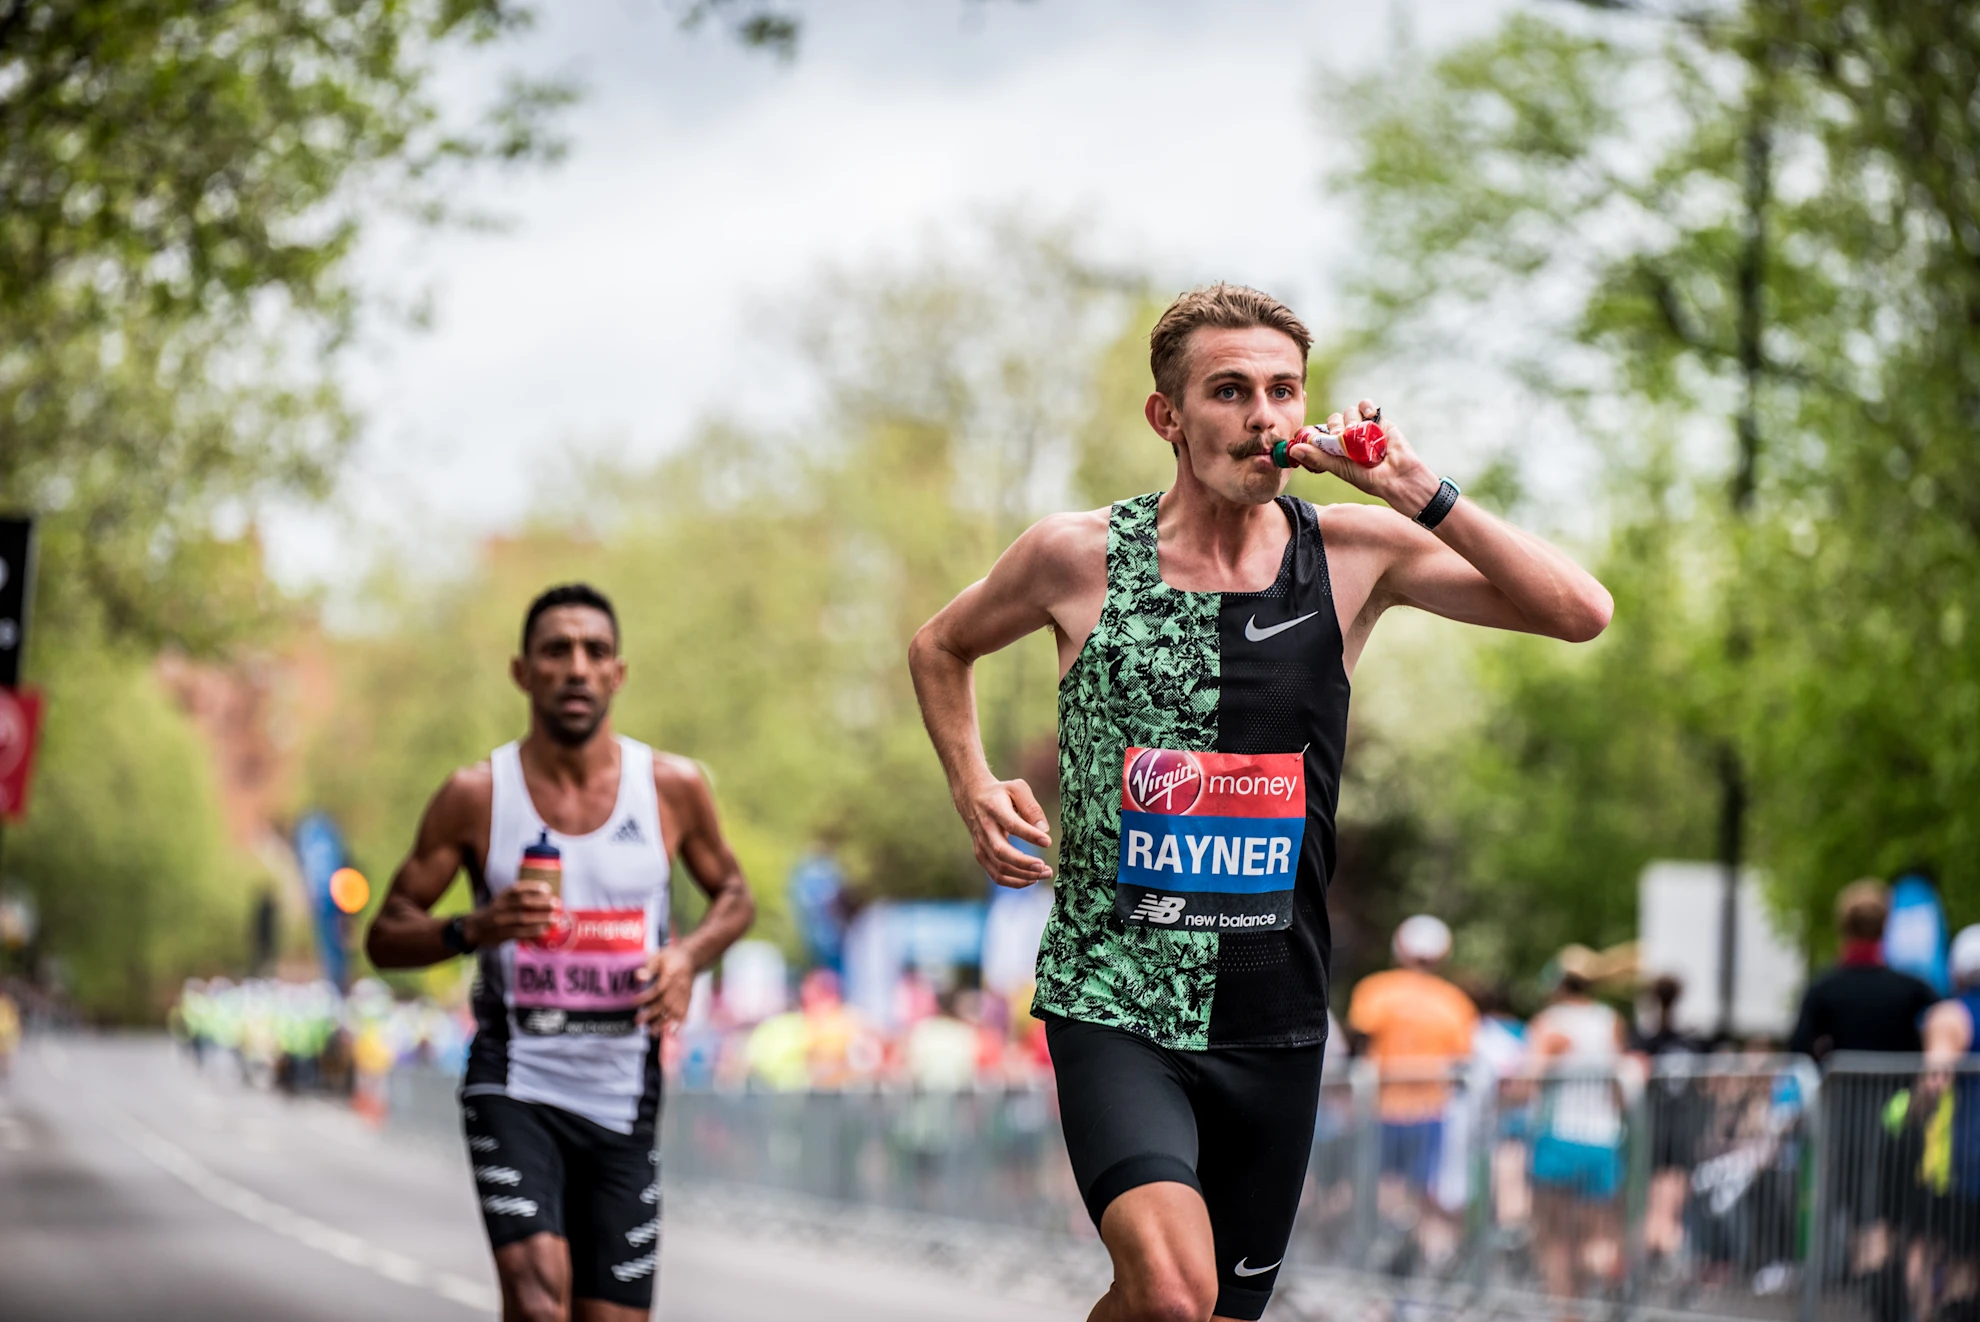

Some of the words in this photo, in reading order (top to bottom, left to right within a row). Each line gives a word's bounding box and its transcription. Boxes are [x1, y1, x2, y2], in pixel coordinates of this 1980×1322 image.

[1132, 751, 1199, 810] Virgin
[1209, 775, 1297, 801] money
[1127, 829, 1292, 876] RAYNER
[1185, 914, 1217, 927] new
[1219, 913, 1277, 928] balance
[518, 964, 557, 993] DA
